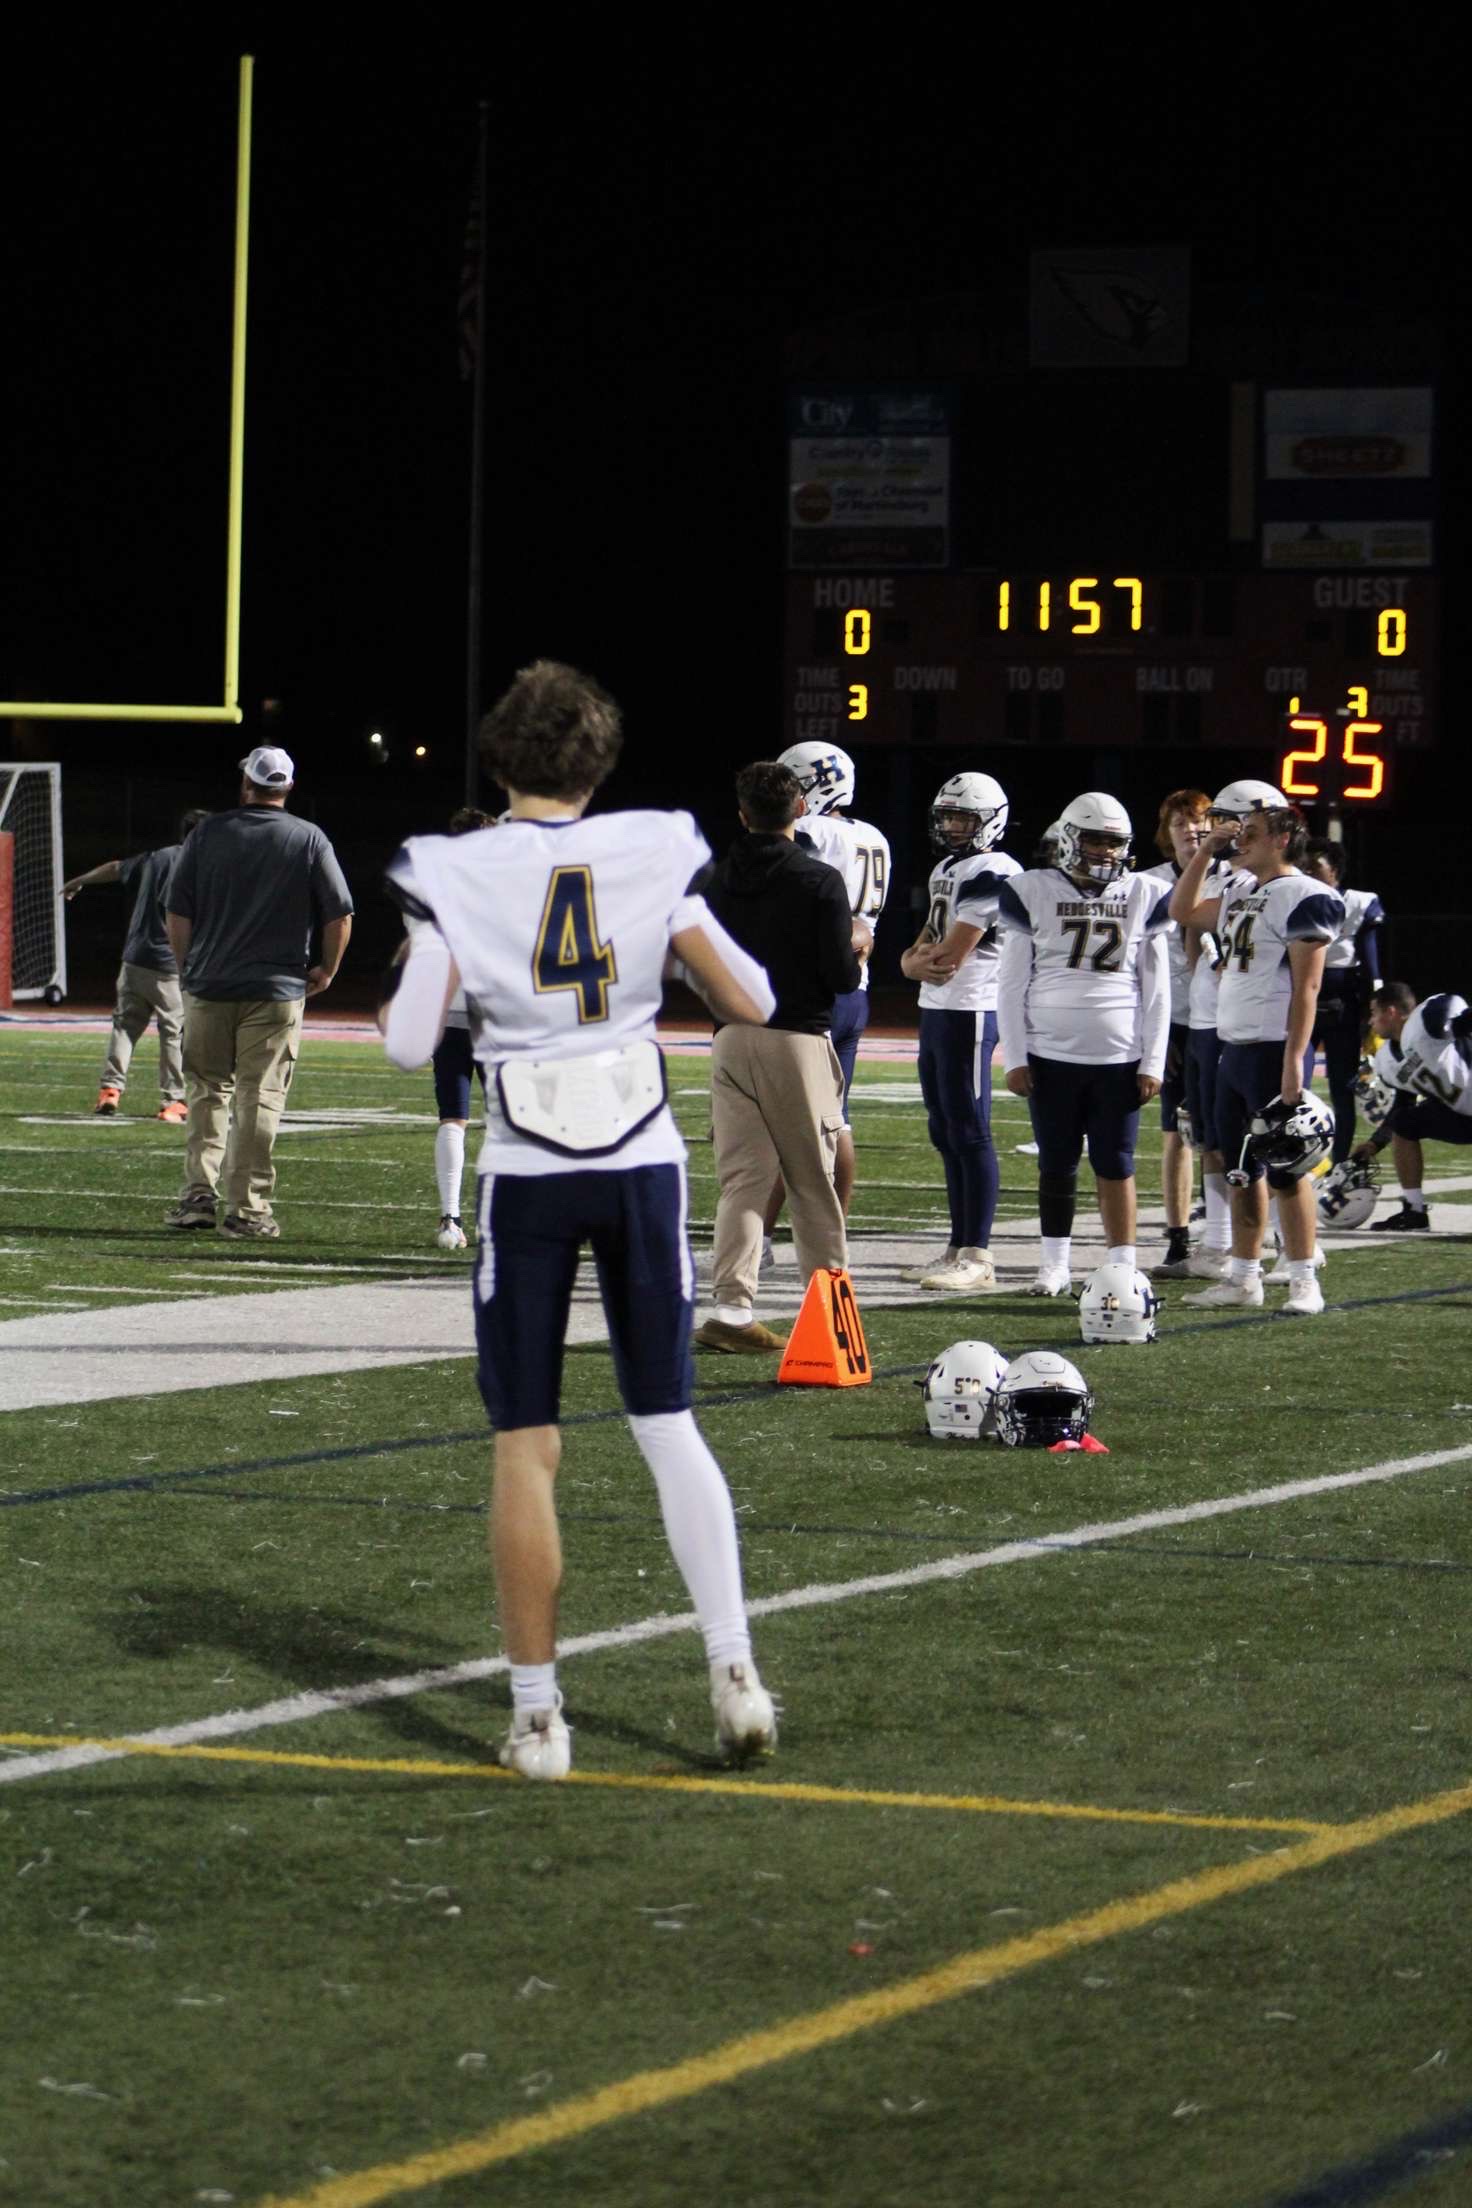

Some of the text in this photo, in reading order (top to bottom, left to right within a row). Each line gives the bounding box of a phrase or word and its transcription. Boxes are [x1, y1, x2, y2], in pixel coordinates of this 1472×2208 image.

[814, 578, 895, 609] HOME
[1313, 577, 1409, 608] GUEST
[843, 608, 872, 656] 0
[1376, 608, 1407, 657] 0
[797, 667, 840, 687] TIME
[893, 666, 958, 690] DOWN
[1007, 667, 1066, 690] TO GO
[1136, 666, 1214, 691] BALL ON
[1264, 667, 1309, 692] QTR
[1374, 668, 1421, 691] TIME
[793, 692, 843, 714] OUTS
[847, 683, 869, 721] 3
[1372, 695, 1424, 716] OUTS
[795, 718, 840, 739] LEFT
[1397, 721, 1420, 743] FT
[809, 754, 846, 788] H
[1280, 717, 1385, 799] 25
[854, 843, 886, 919] 79
[1055, 902, 1129, 919] HEDGESVILLE
[530, 862, 619, 1026] 4
[1060, 918, 1124, 973] 72
[830, 1280, 867, 1374] 40
